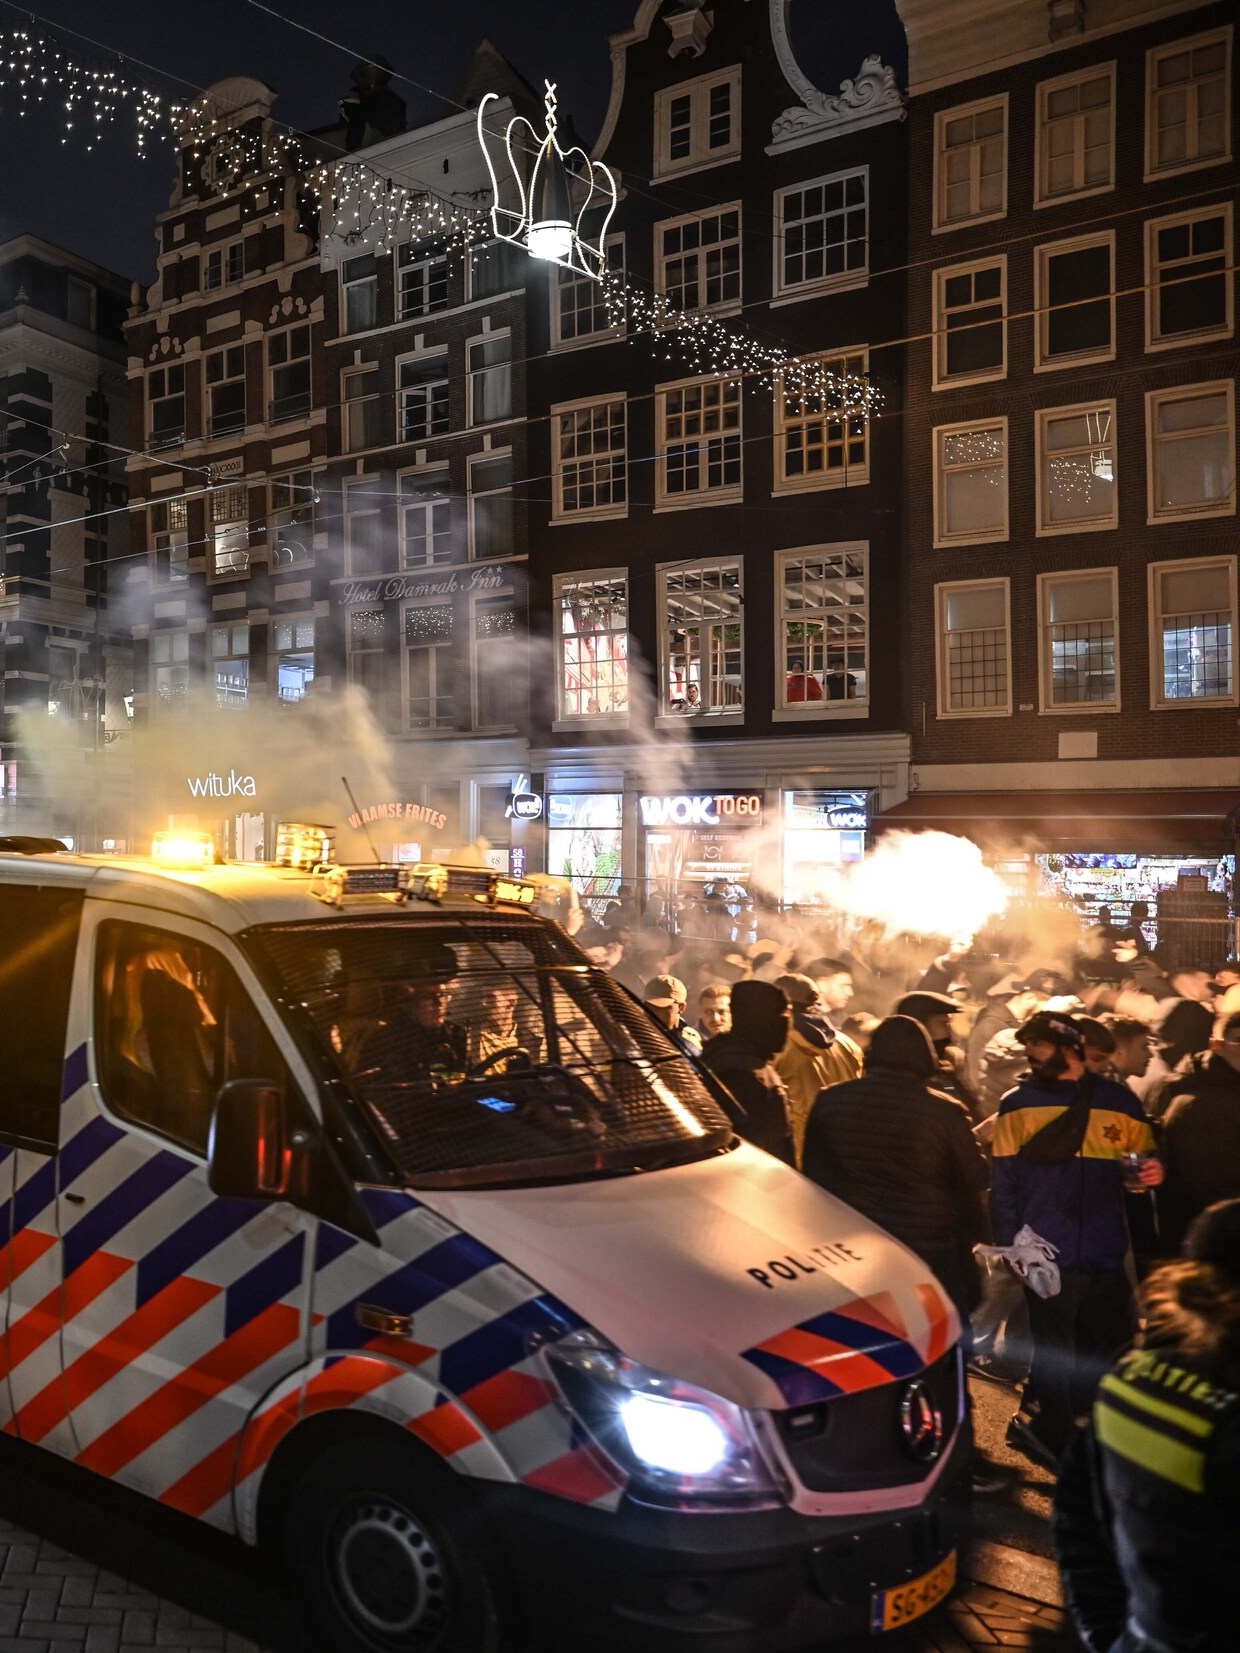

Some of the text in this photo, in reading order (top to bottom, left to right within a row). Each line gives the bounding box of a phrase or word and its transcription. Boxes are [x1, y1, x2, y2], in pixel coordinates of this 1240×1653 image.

[339, 566, 504, 605] Hotel Damrak Inn
[187, 769, 257, 798] wituka
[348, 802, 447, 830] VLAAMSE FRITES
[640, 796, 760, 825] WOK TO GO
[490, 856, 501, 867] 58
[512, 848, 523, 857] 58
[745, 1242, 863, 1289] POLITIE
